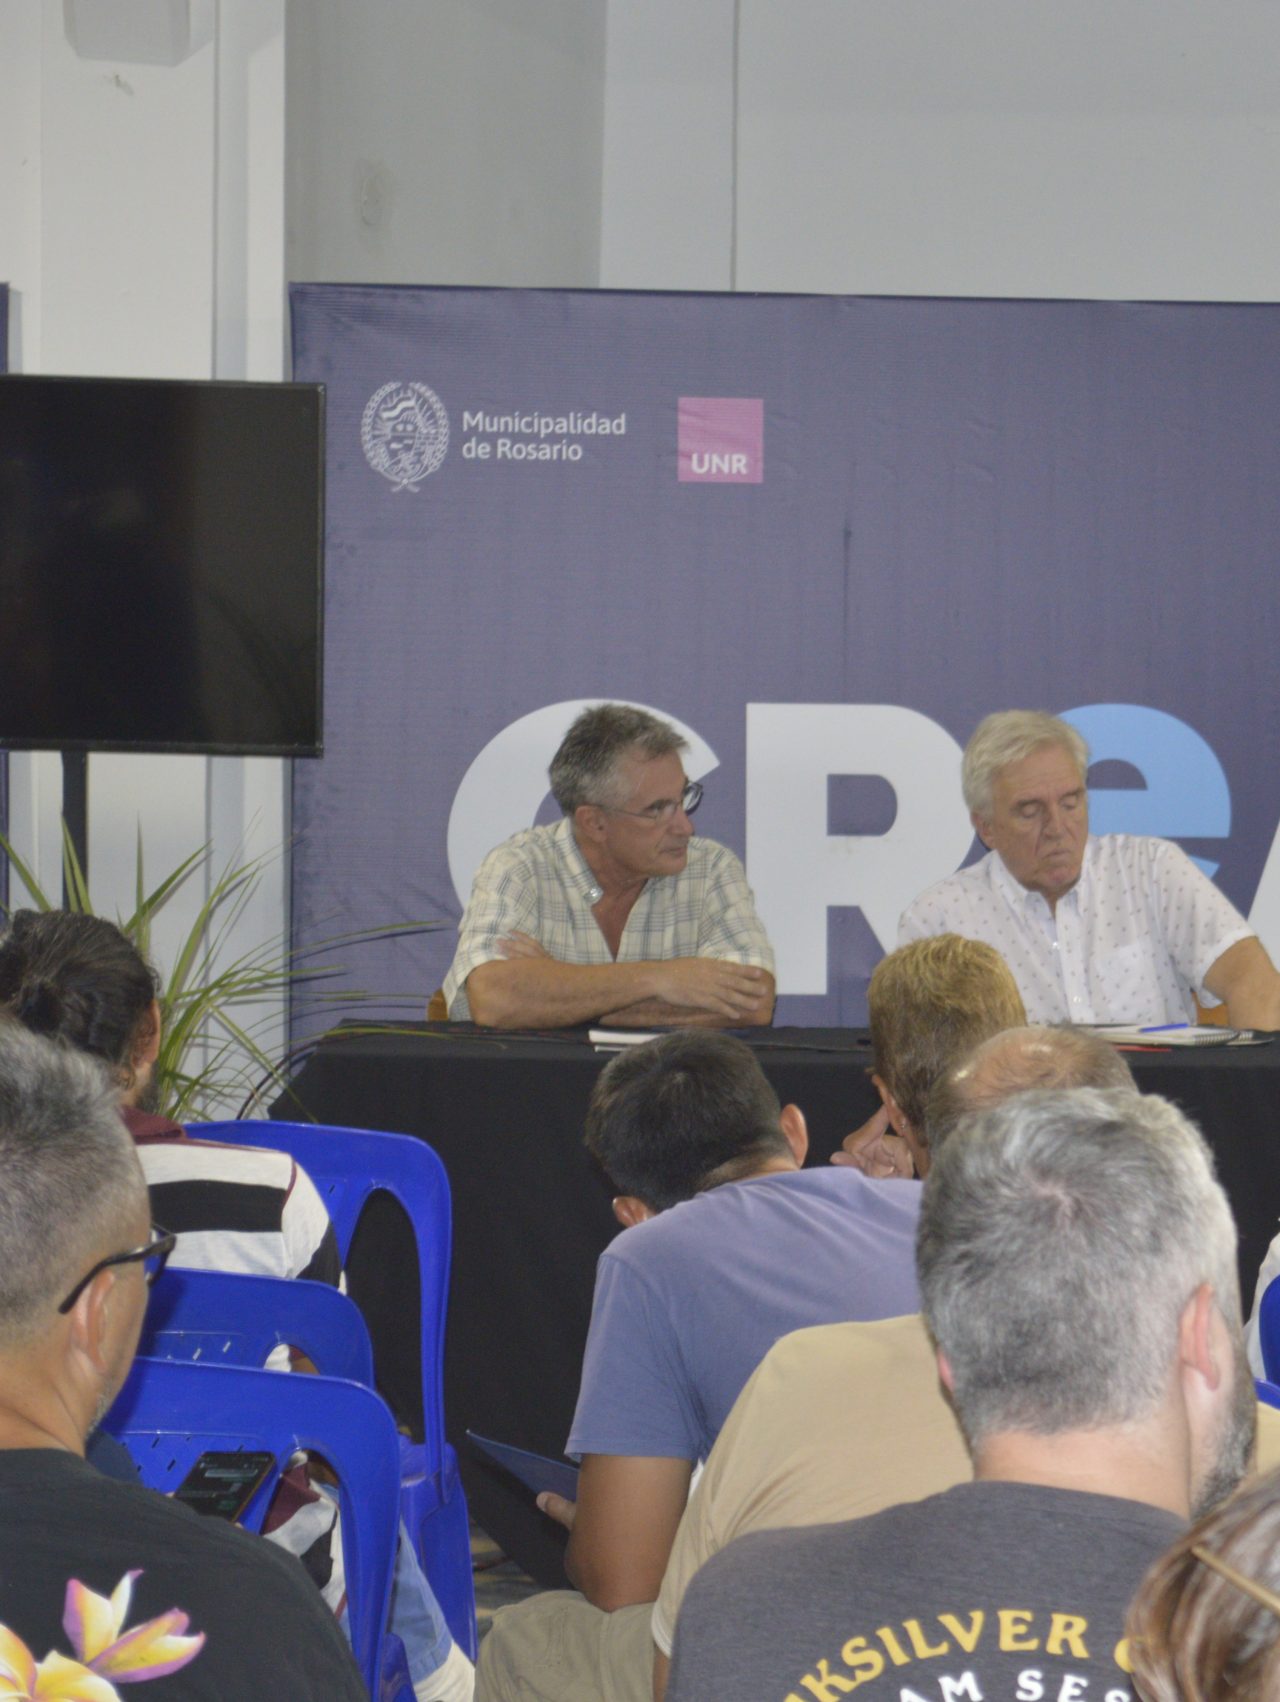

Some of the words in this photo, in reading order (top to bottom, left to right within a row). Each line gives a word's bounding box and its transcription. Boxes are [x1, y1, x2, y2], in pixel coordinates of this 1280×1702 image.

[462, 411, 626, 438] Municipalidad
[462, 436, 491, 459] de
[497, 438, 583, 461] Rosario
[691, 453, 748, 474] UNR
